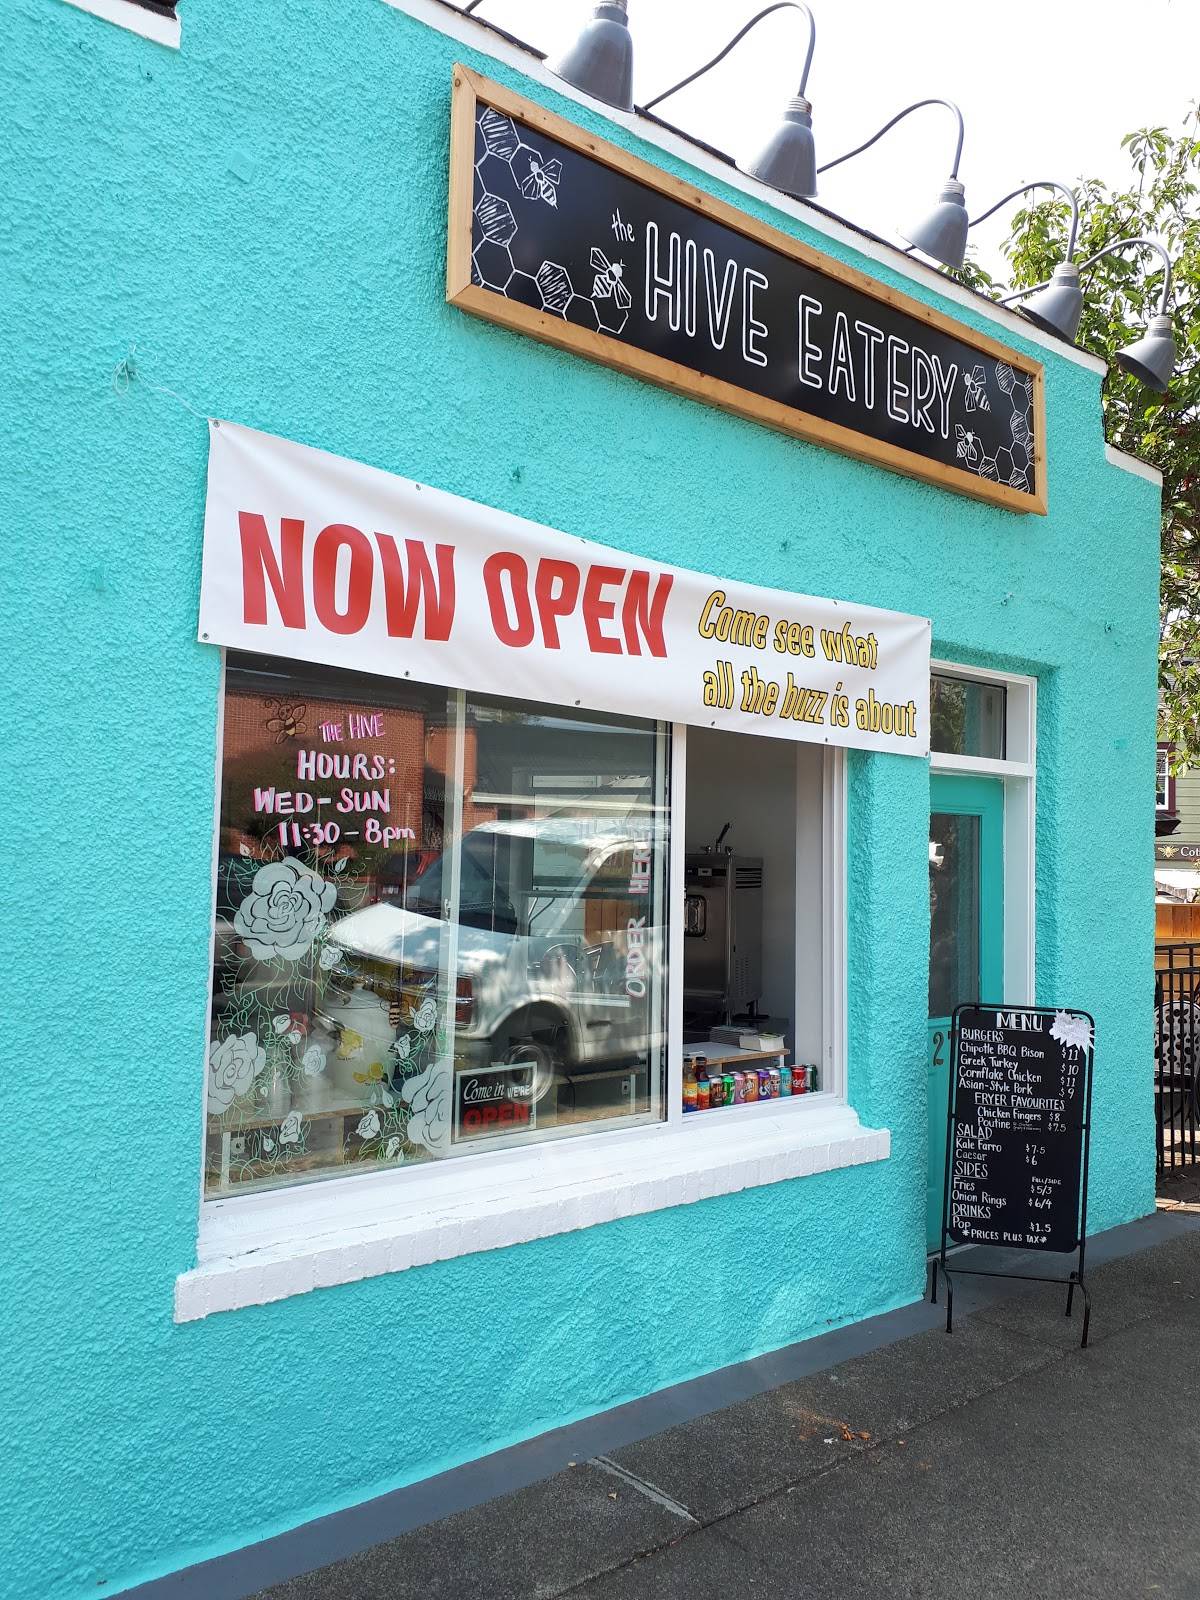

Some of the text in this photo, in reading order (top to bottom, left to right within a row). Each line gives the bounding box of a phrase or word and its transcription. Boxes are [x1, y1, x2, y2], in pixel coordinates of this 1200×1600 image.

[612, 208, 635, 243] the
[645, 221, 958, 440] HIVE EATERY
[238, 511, 674, 658] NOW OPEN
[698, 590, 878, 670] Come see what
[703, 660, 917, 737] all the buzz is about
[319, 712, 387, 743] THE HIVE
[297, 750, 396, 781] HOURS:
[278, 822, 341, 848] 11:30
[365, 818, 416, 849] 8pm
[996, 1012, 1044, 1031] MENU
[961, 1028, 1004, 1042] BURGERS
[960, 1041, 994, 1055] Chipotle
[997, 1044, 1017, 1057] BBQ
[1021, 1046, 1045, 1059] Bison
[960, 1054, 986, 1067] Greek
[989, 1056, 1018, 1072] Turkey
[959, 1065, 1004, 1080] Cornflake
[1008, 1069, 1042, 1083] Chicken
[463, 1079, 492, 1101] Come
[494, 1082, 505, 1097] in
[1014, 1083, 1033, 1095] Pork
[974, 1092, 1066, 1110] FRYER FAVOURITES
[463, 1103, 529, 1132] OPEN
[977, 1106, 1061, 1123] Chicken Fingers $8
[977, 1117, 1011, 1129] Poutine
[956, 1122, 993, 1139] SALAD
[955, 1138, 975, 1150] Kale
[978, 1140, 1002, 1152] Farro
[955, 1149, 988, 1161] Caesar
[955, 1160, 989, 1178] SIDES
[953, 1177, 975, 1191] Fries
[952, 1190, 978, 1202] Onion
[982, 1192, 1007, 1209] Rings
[952, 1203, 991, 1218] DRINKS
[953, 1216, 971, 1230] Pop
[1003, 1232, 1022, 1242] PLUS
